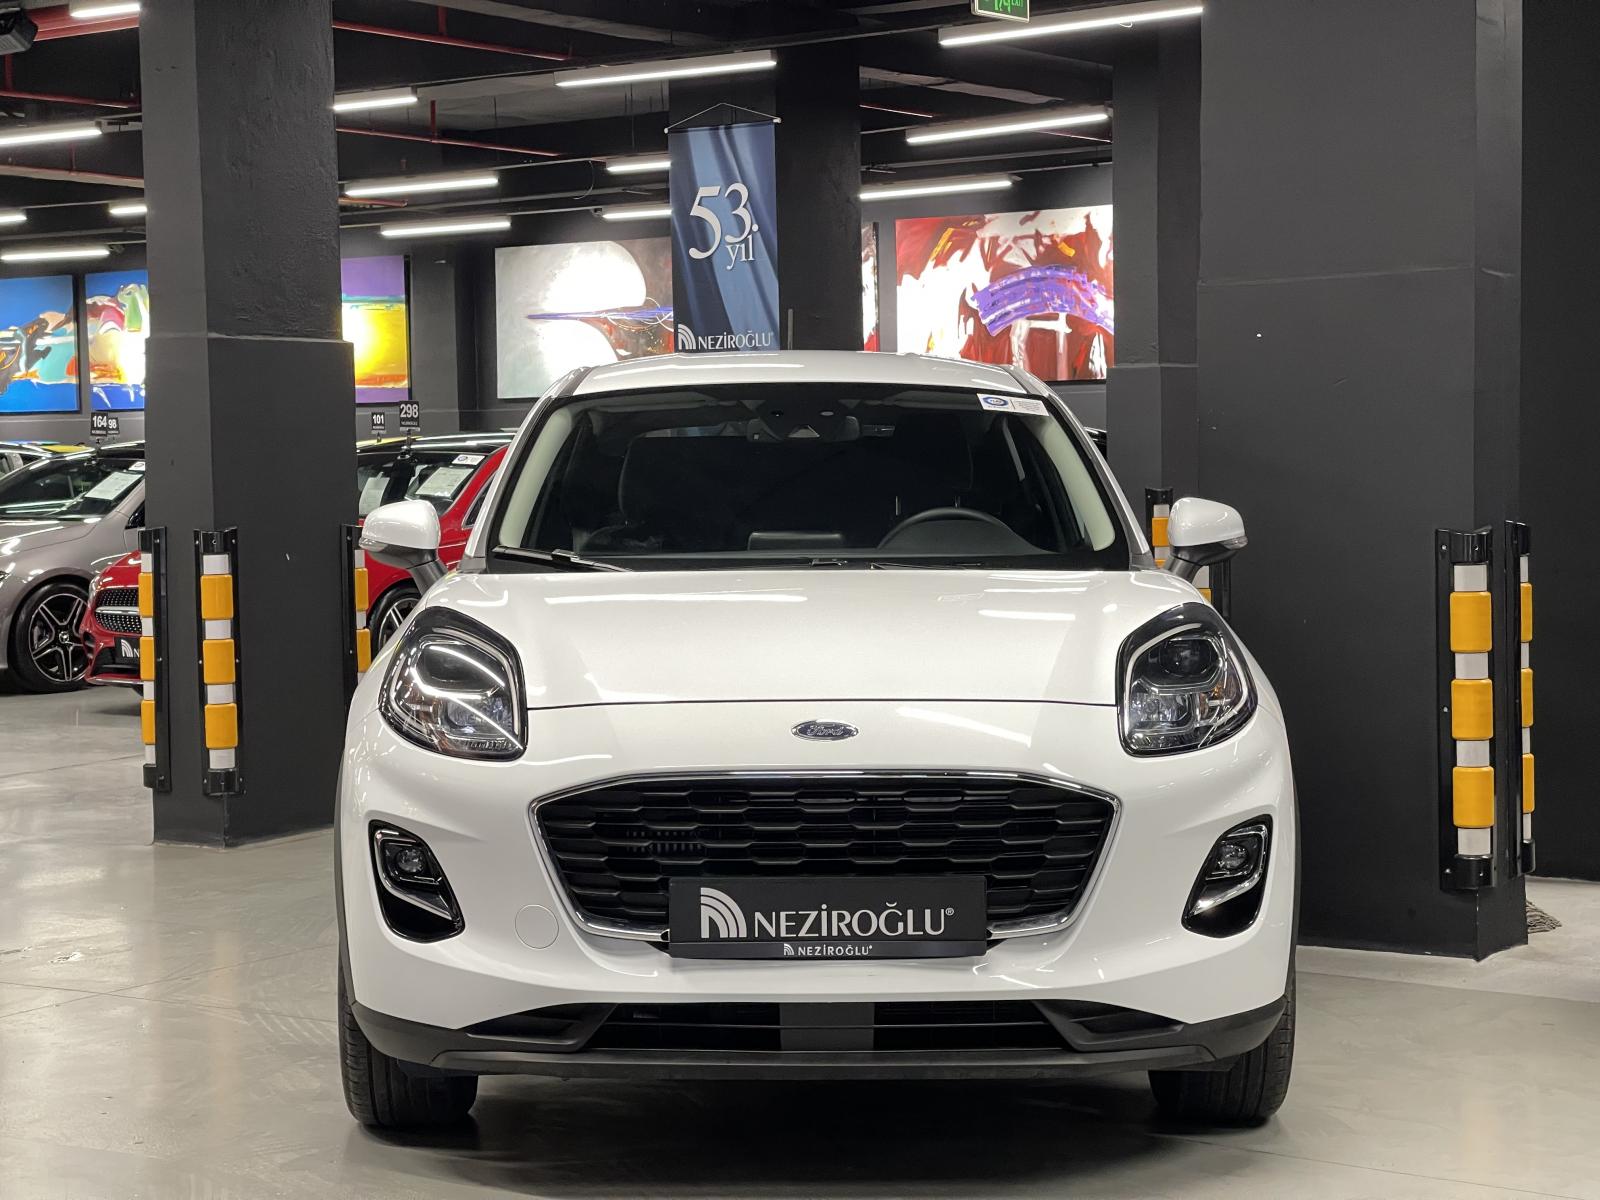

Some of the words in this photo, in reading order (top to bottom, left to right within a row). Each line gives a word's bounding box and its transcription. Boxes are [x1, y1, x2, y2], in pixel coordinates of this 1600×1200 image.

[688, 183, 759, 260] 53.
[725, 234, 755, 270] yıl
[400, 403, 419, 418] 298
[92, 415, 107, 428] 164
[372, 414, 384, 424] 101
